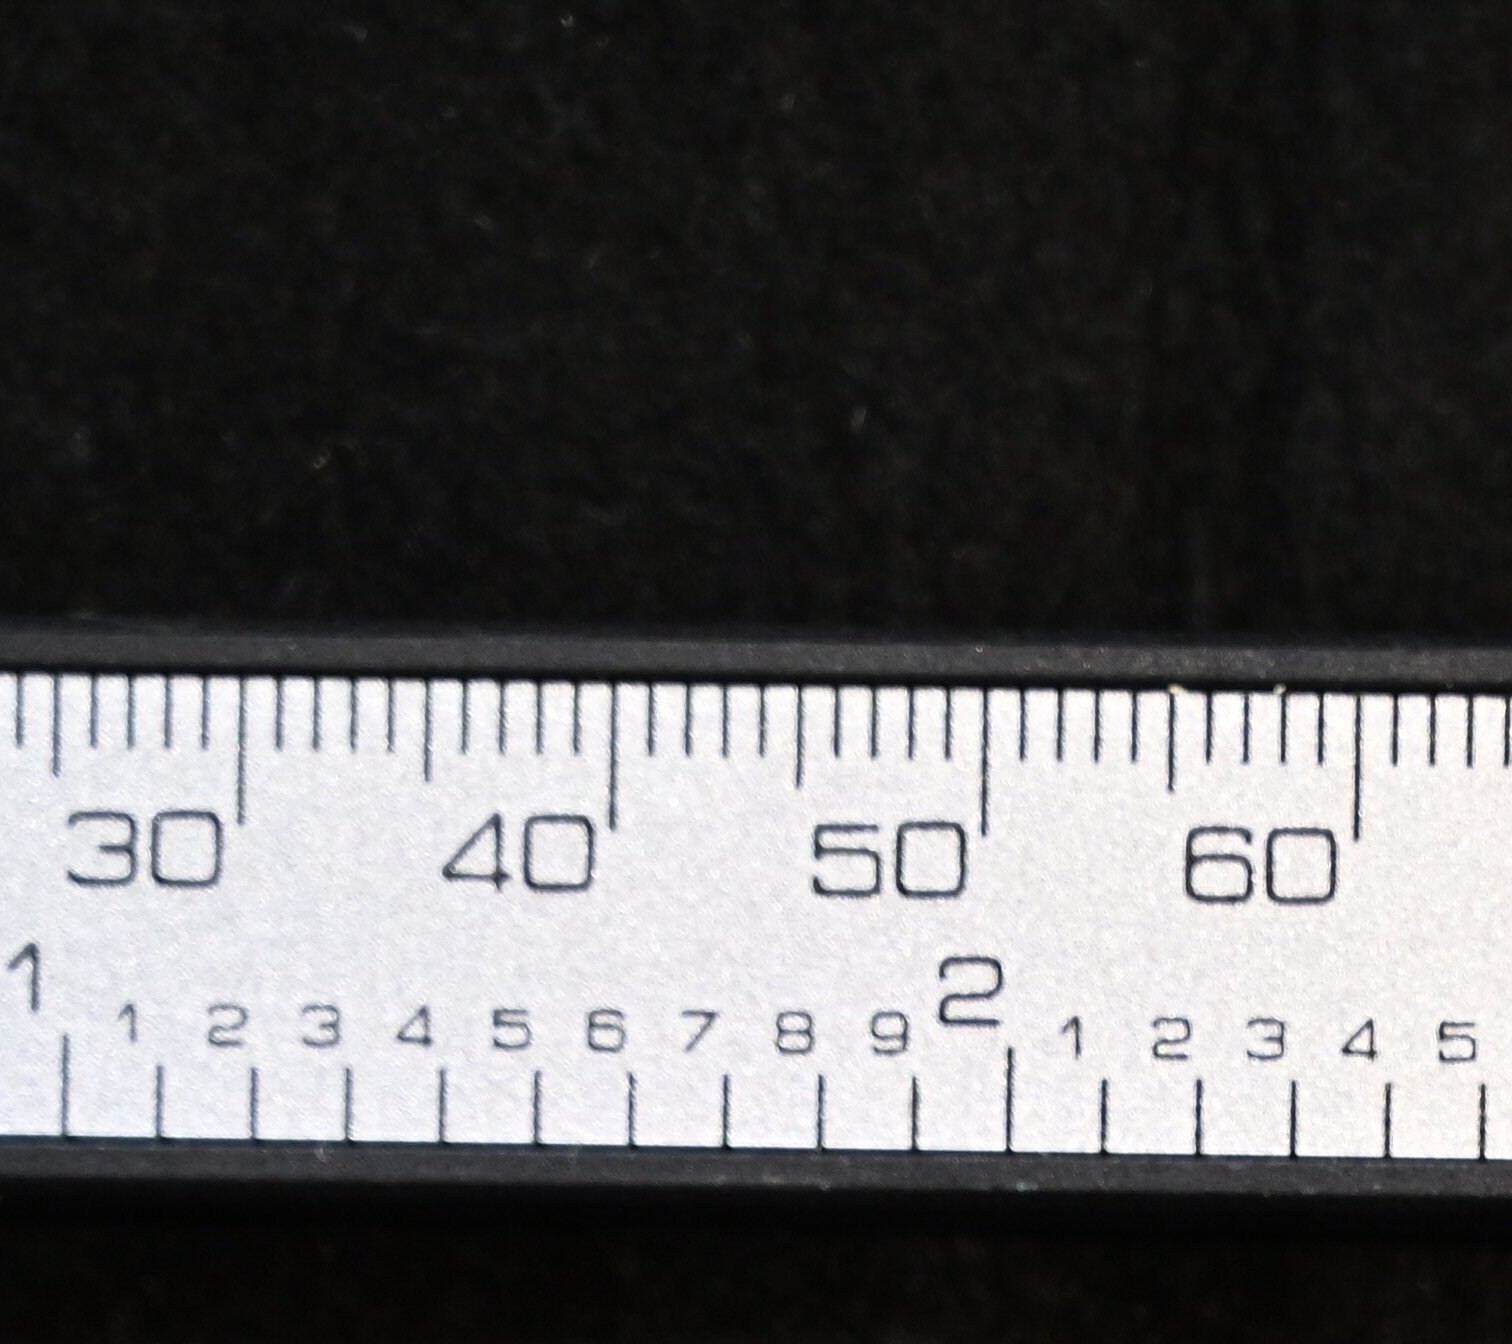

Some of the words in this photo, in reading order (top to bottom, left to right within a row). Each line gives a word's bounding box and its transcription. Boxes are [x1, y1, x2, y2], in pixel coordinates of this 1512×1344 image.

[65, 808, 225, 891] 30
[440, 811, 606, 895] 40
[810, 818, 969, 902] 50
[1182, 823, 1340, 908] 60
[6, 941, 42, 1014] 1
[935, 954, 1006, 1029] 2
[118, 1002, 138, 1043] 1
[206, 1002, 249, 1049] 2
[301, 1003, 342, 1050] 3
[395, 1005, 434, 1049] 4
[491, 1007, 532, 1052] 5
[585, 1007, 627, 1054] 6
[681, 1009, 720, 1053] 7
[774, 1009, 816, 1057] 8
[869, 1009, 911, 1058] 9
[1060, 1015, 1083, 1059] 1
[1151, 1015, 1193, 1062] 2
[1245, 1016, 1287, 1063] 3
[1340, 1018, 1379, 1062] 4
[1436, 1020, 1478, 1065] 5
